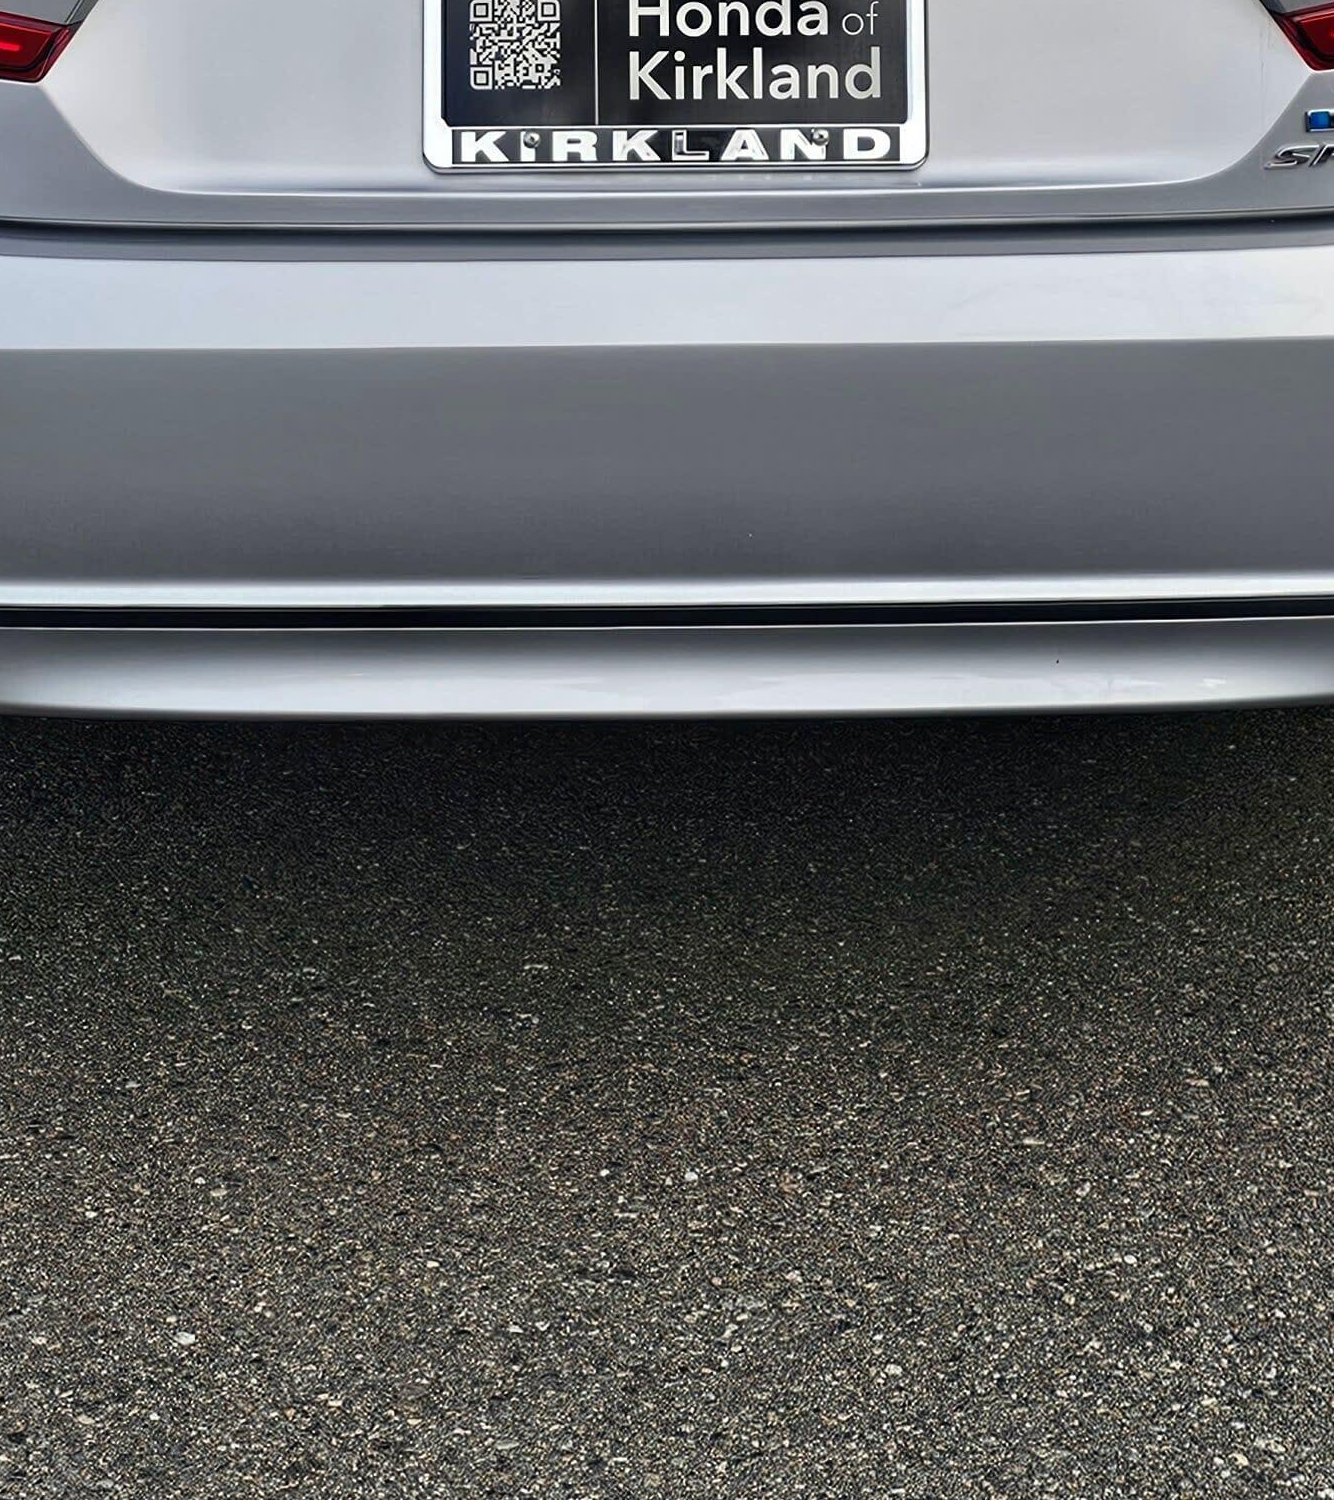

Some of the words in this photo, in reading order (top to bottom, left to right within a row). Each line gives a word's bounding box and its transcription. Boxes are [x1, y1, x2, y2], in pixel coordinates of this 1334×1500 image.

[841, 0, 879, 37] of
[628, 46, 882, 100] Kirkland
[460, 128, 892, 162] KIRKLAND
